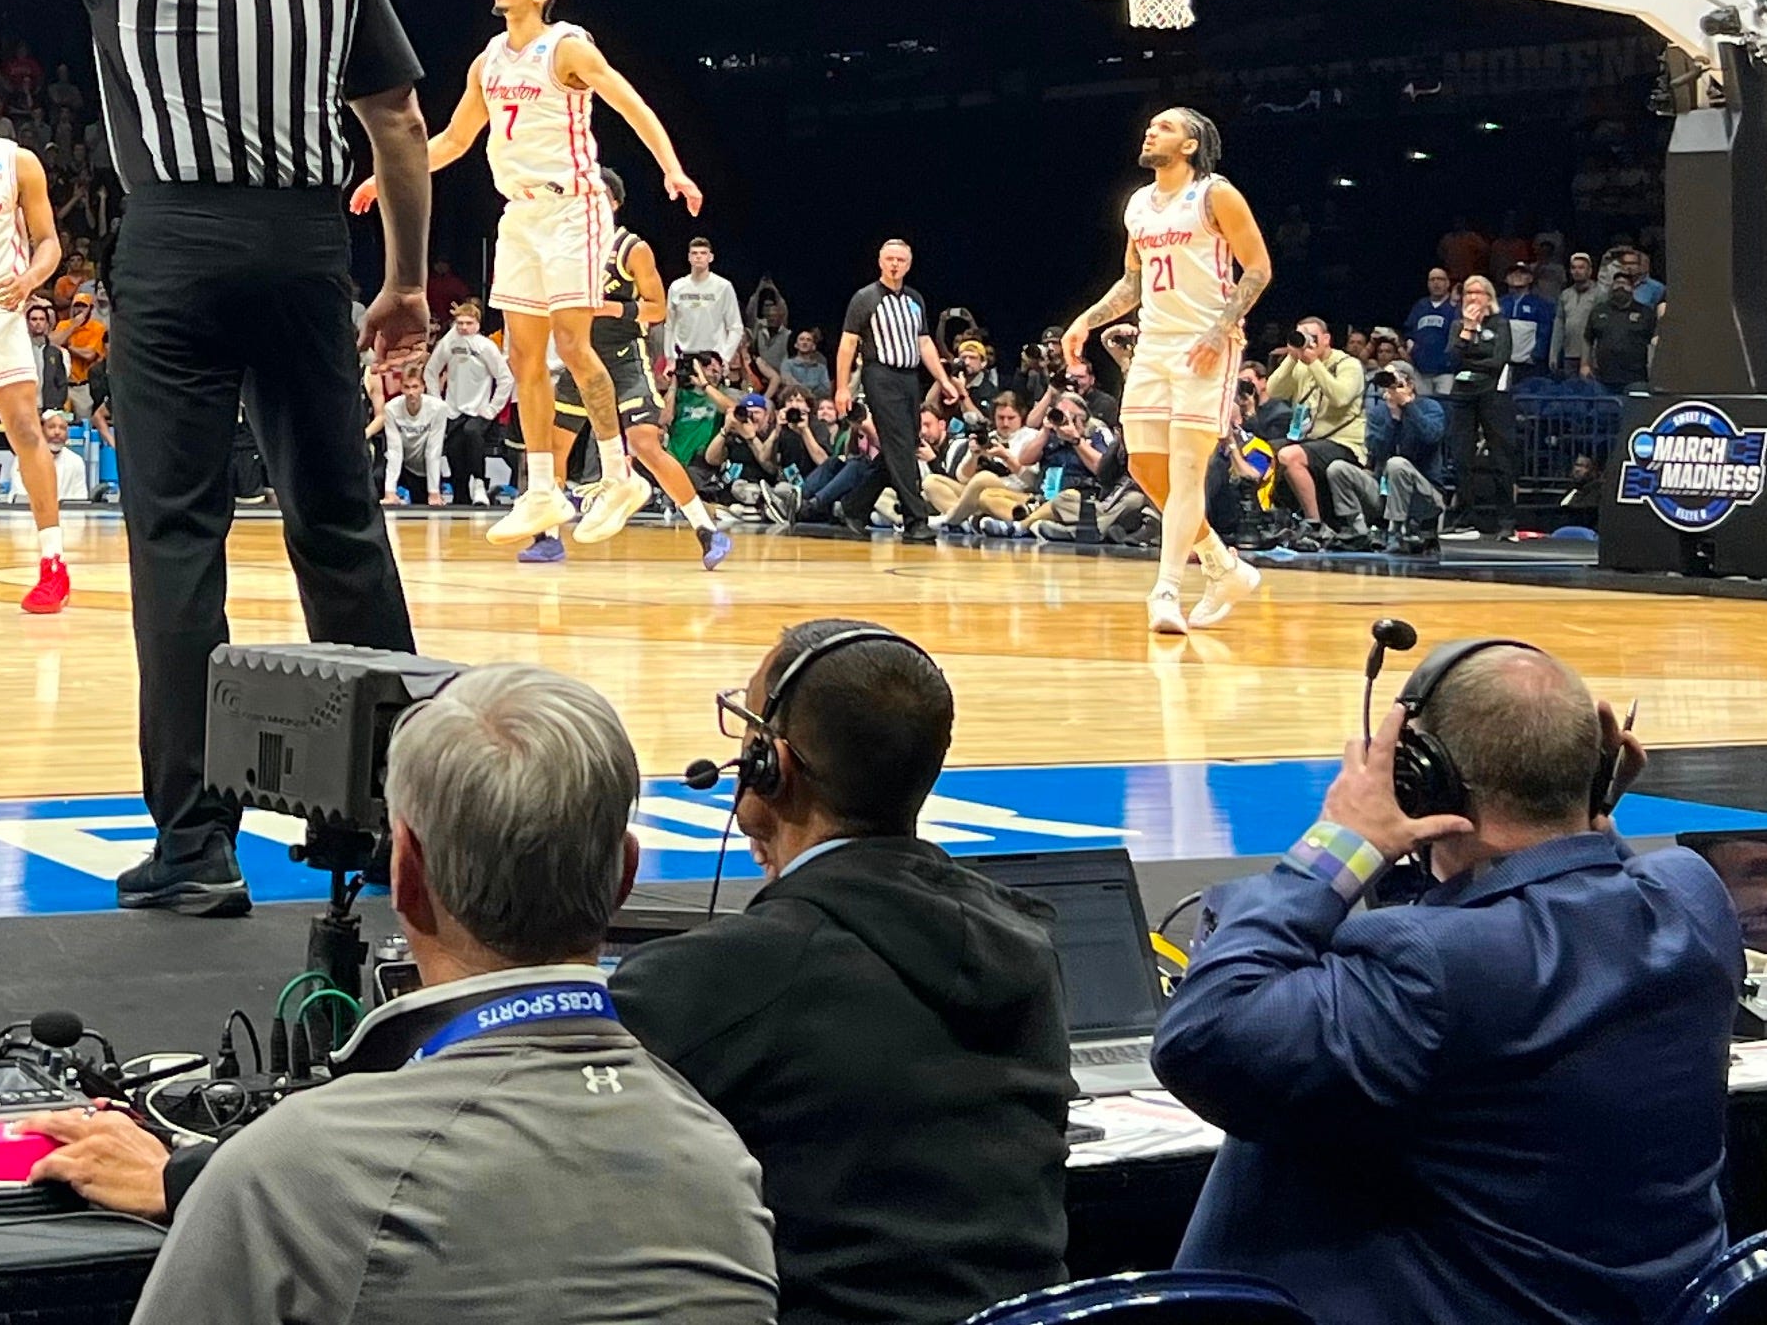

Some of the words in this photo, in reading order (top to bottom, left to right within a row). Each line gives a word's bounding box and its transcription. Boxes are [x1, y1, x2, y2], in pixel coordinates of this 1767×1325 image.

[486, 75, 541, 101] Houston
[502, 104, 518, 141] 7
[1132, 227, 1193, 250] Houston
[1149, 254, 1175, 292] 21
[1653, 436, 1728, 463] MARCH
[1661, 462, 1761, 492] MADNESS
[477, 995, 555, 1028] SPORTS
[558, 991, 592, 1011] CBS
